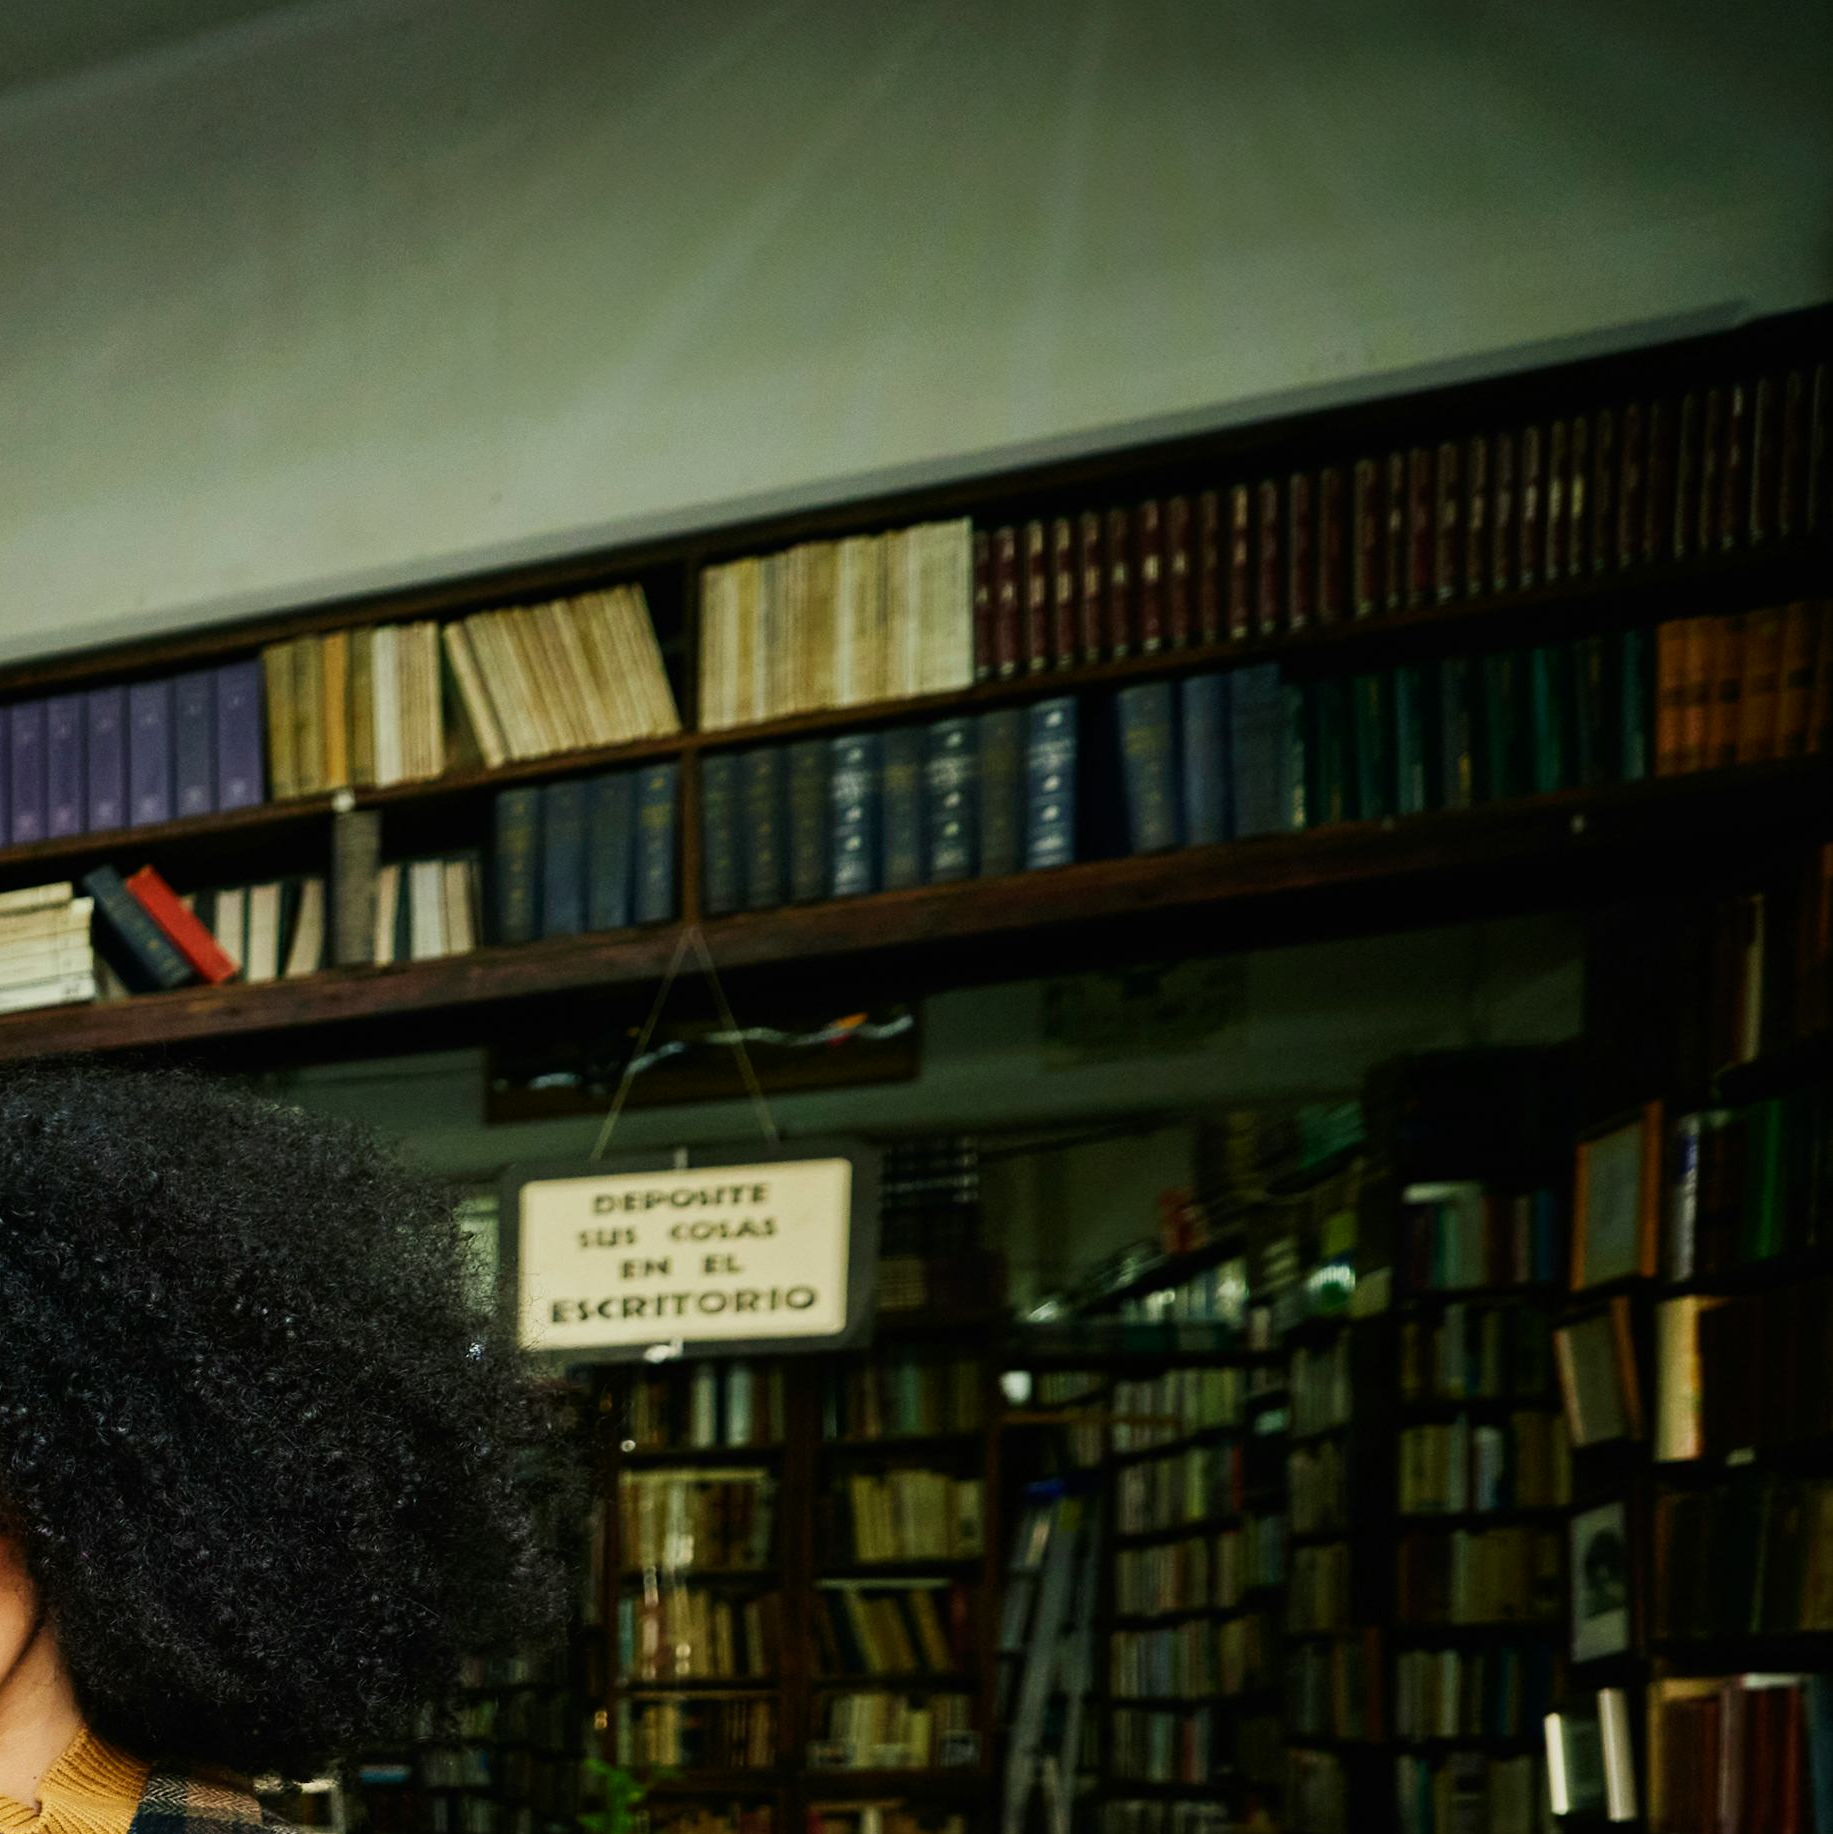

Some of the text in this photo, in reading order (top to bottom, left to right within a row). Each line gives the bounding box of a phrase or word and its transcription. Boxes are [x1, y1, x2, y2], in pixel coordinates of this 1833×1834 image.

[593, 1182, 769, 1215] DEPOSITE
[578, 1217, 777, 1249] SUS COSAS
[620, 1255, 744, 1281] EN EL
[550, 1286, 819, 1324] ESCRITORIO
